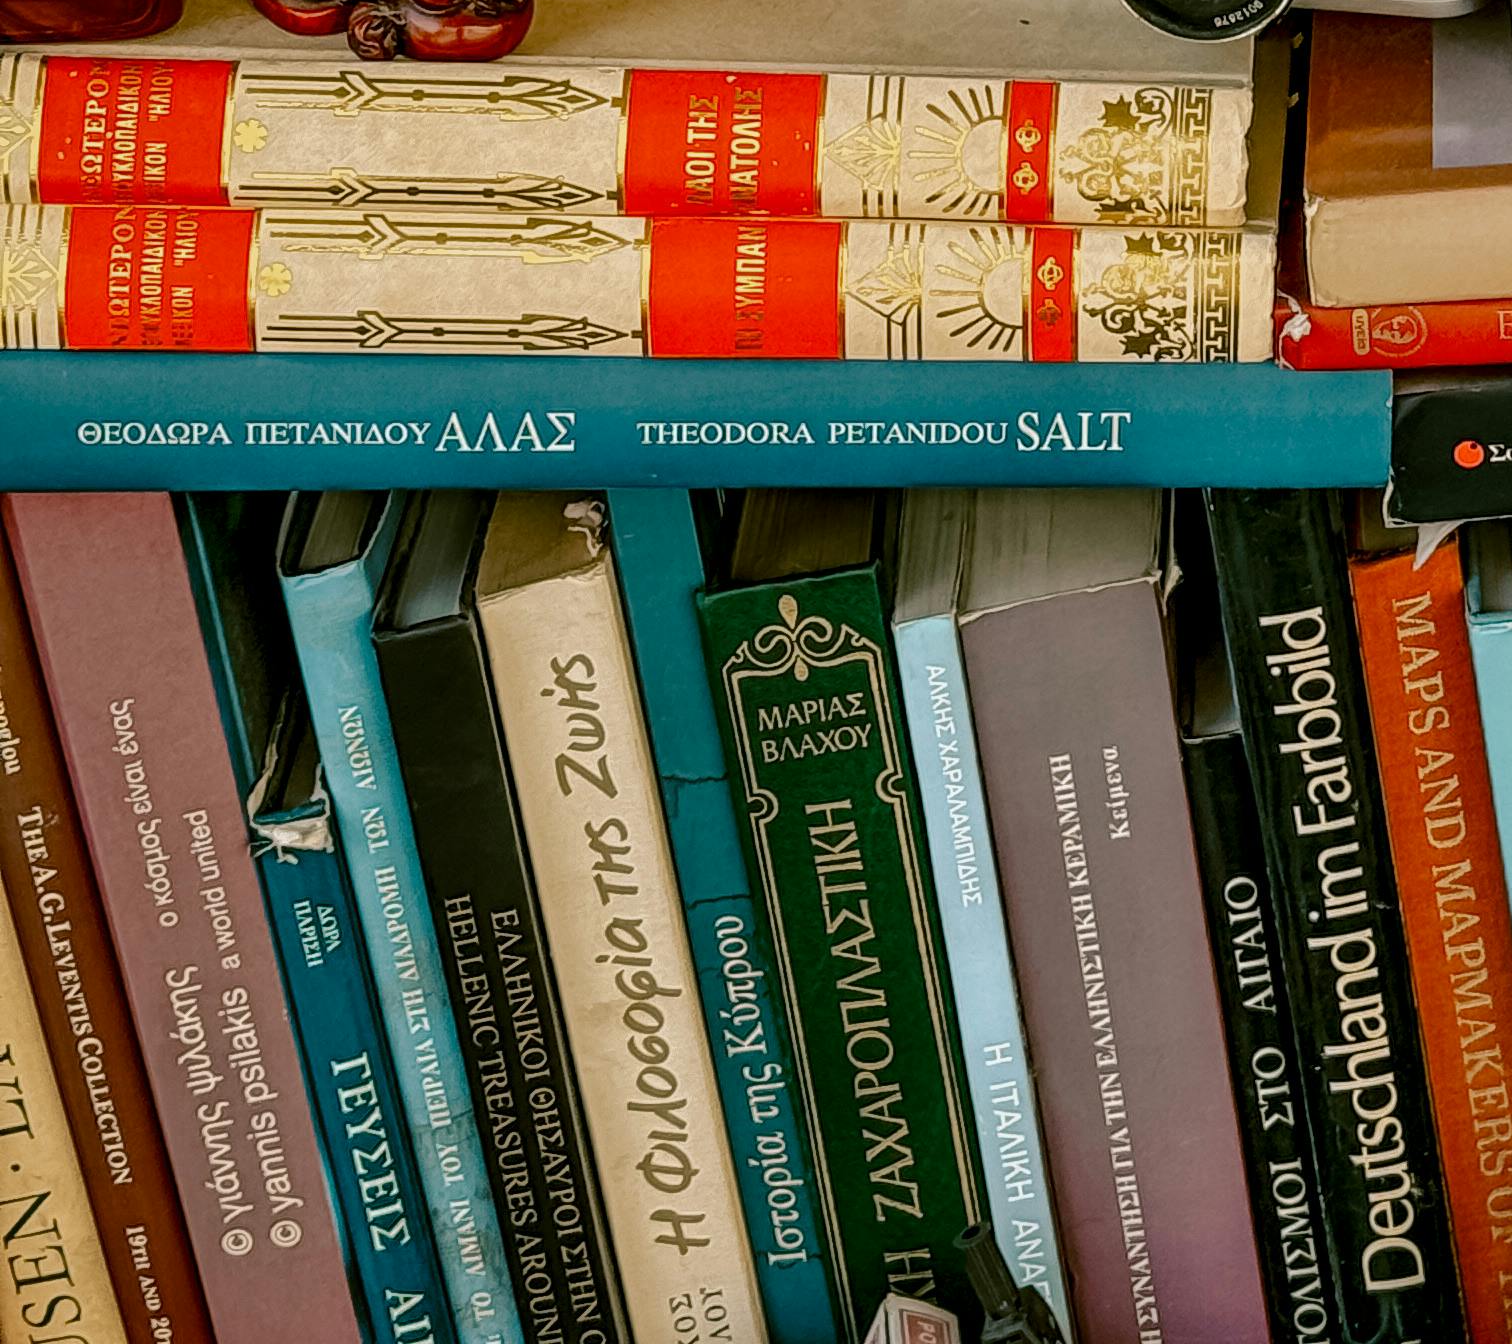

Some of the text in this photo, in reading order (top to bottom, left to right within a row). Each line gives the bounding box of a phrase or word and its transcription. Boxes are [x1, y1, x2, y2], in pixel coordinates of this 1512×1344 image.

[78, 411, 577, 453] ΘΕΟΔΩΡΑ ΠΕΤΑΝΙΔΟΥ ΑΛΑΣ
[637, 411, 1132, 451] THEODORA PETANIDOU SALT
[758, 692, 866, 731] ΜΑΡΙΑΣ
[1393, 592, 1449, 738] MAPS
[761, 724, 872, 764] ΒΛΑΧΟΥ
[1102, 745, 1130, 841] Κείμενα
[1413, 747, 1467, 851] AND
[804, 797, 924, 1223] ΖΑΧΑΡΟΠΛΑΣΤΙΚΗ
[1258, 607, 1428, 1292] Deutschland im Farbbild
[444, 895, 541, 1226] HELLENIC TREASURES
[714, 914, 807, 1265] Ιστορία της Κύπρου
[330, 1052, 409, 1251] ΓΕΥΣΕΙΣ
